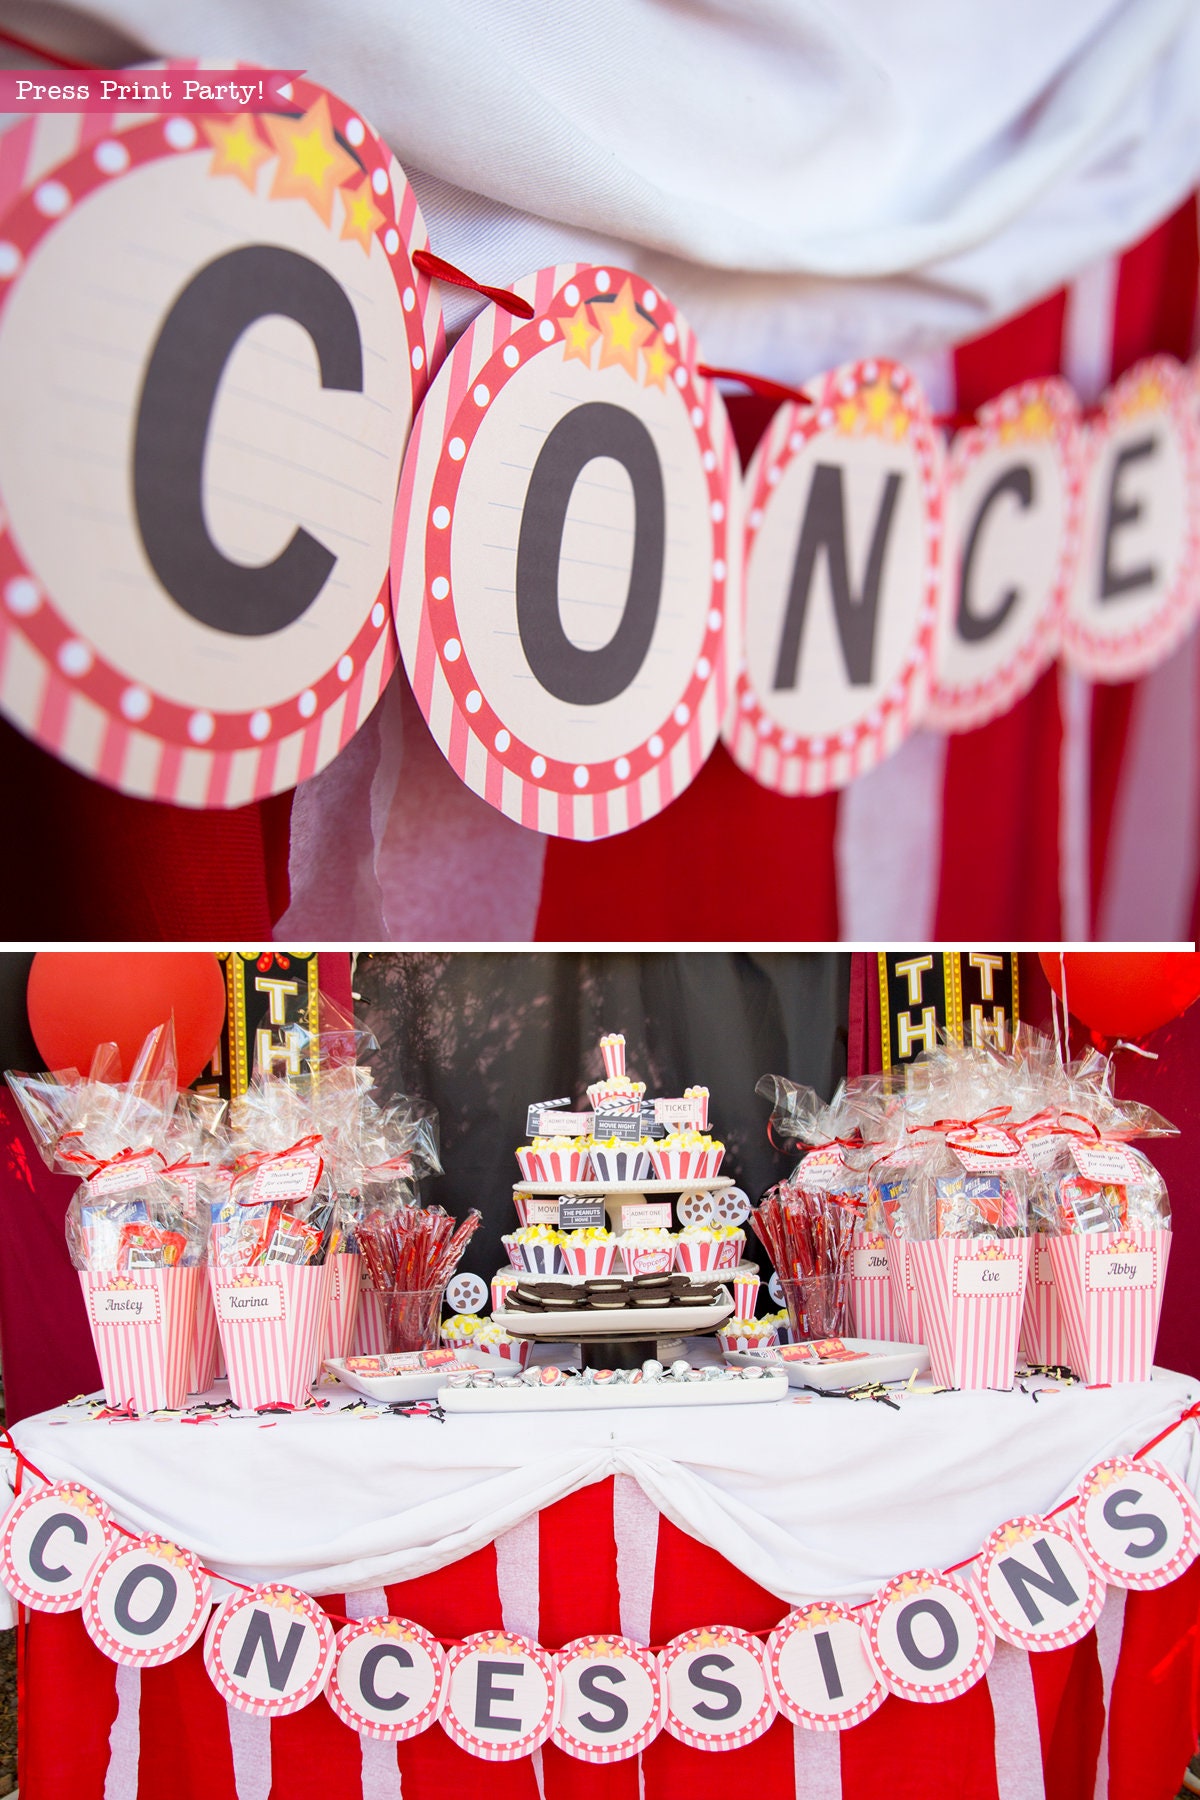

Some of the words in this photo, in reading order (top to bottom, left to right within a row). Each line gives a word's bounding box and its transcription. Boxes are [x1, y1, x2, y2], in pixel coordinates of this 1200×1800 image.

[664, 1104, 692, 1112] TICKET
[868, 1256, 889, 1271] Abb
[1107, 1262, 1137, 1280] Abby
[981, 1269, 1001, 1282] Eve
[105, 1298, 143, 1315] Ansley
[229, 1295, 269, 1309] Karina
[28, 1488, 1168, 1733] CONCESSIONS
